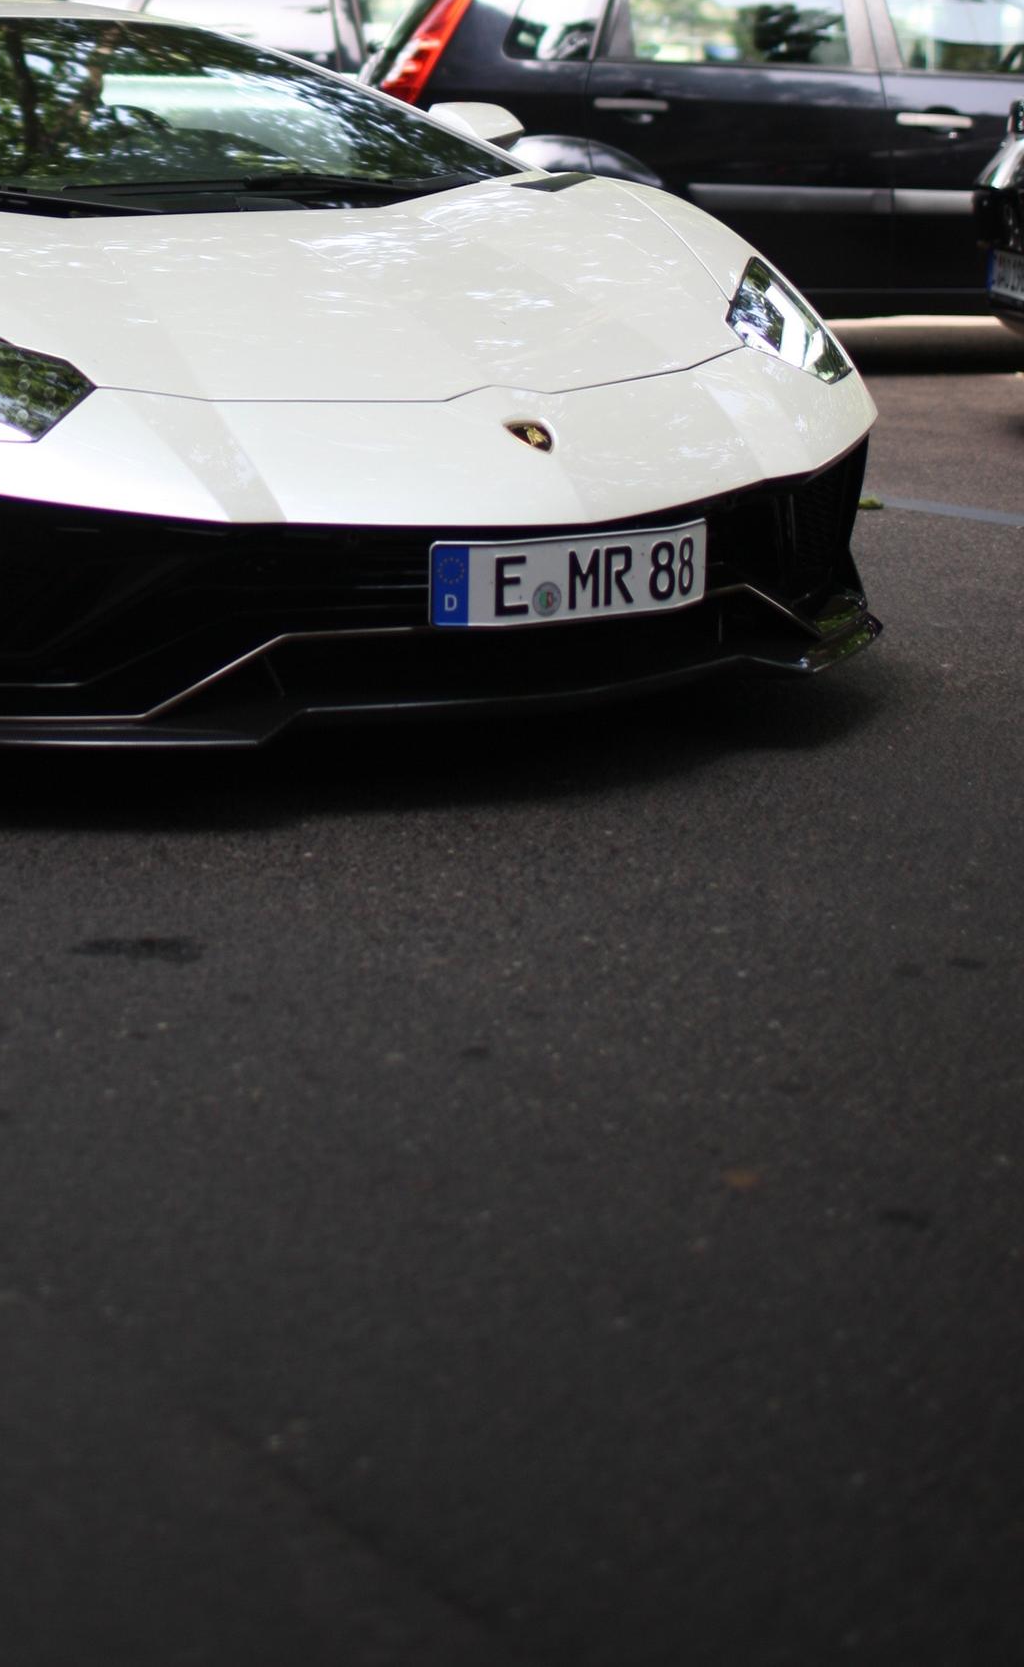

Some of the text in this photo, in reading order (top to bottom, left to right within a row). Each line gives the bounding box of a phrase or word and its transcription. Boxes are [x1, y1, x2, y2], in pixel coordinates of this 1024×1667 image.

[495, 534, 694, 617] E MR 88
[444, 594, 458, 612] D
